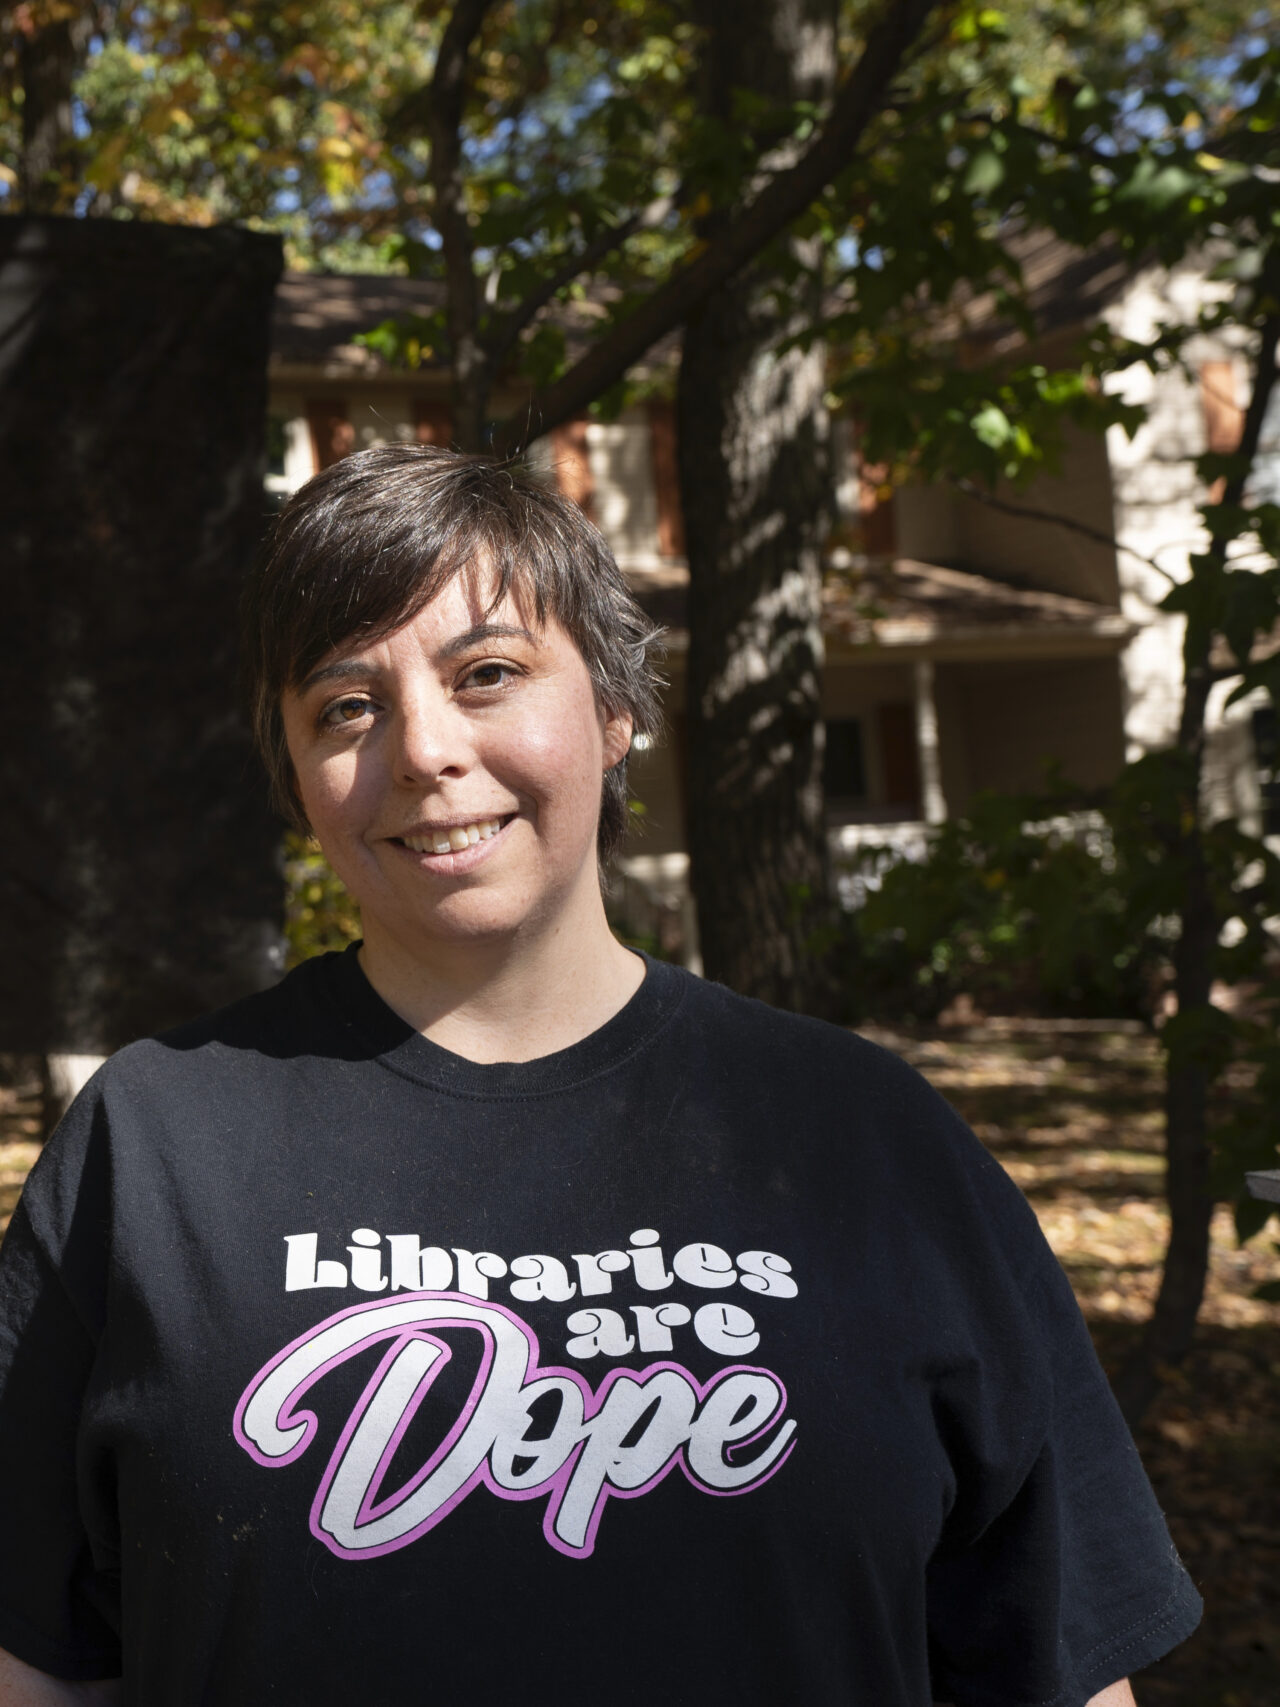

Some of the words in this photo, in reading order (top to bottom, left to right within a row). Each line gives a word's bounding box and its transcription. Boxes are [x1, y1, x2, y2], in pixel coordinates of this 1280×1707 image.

[283, 1228, 799, 1302] Libraries
[565, 1302, 760, 1359] are
[233, 1291, 797, 1560] Dope
